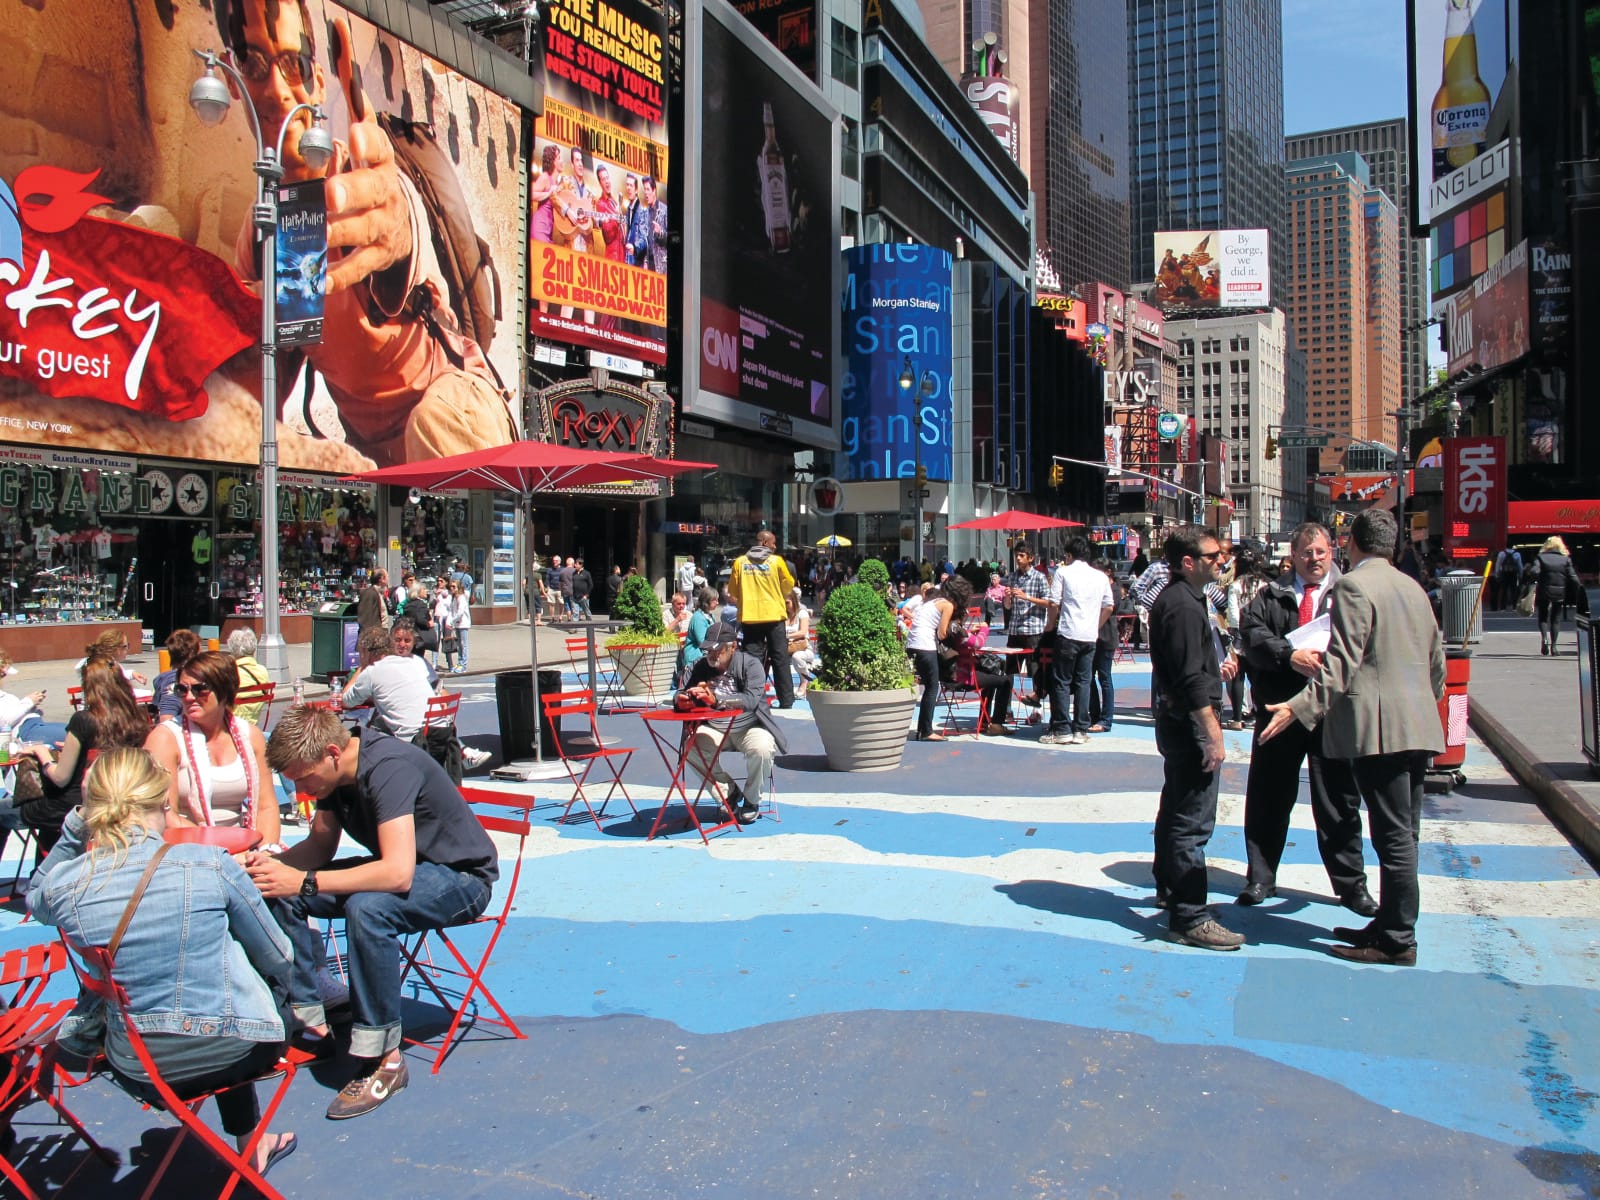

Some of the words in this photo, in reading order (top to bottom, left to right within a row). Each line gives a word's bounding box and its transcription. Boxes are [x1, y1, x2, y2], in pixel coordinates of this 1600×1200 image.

[598, 1, 662, 61] MUSIC
[550, 6, 581, 37] YOU
[583, 23, 664, 84] REMEMBER.
[546, 26, 575, 60] THE
[621, 67, 662, 106] YOU'LL
[546, 52, 601, 94] NEVER
[1437, 107, 1487, 126] Corona
[1447, 121, 1479, 132] Extra
[1430, 143, 1510, 209] INGLOT
[281, 213, 302, 232] Harry
[301, 210, 324, 232] Potter
[1225, 245, 1263, 257] George,
[1238, 234, 1250, 246] By
[1237, 257, 1251, 265] we
[1532, 247, 1571, 271] RAIN
[542, 247, 574, 285] 2nd
[577, 256, 629, 298] SMASH
[632, 270, 665, 307] YEAR
[1231, 266, 1246, 276] did
[1228, 283, 1260, 291] LEADERSHIP
[542, 280, 568, 299] ON
[572, 287, 665, 322] BROADWAY!
[872, 298, 909, 309] Morgan
[909, 298, 940, 313] Stanley
[702, 327, 737, 374] CNN
[37, 348, 111, 379] guest
[743, 358, 758, 372] Japan
[758, 363, 767, 376] PM
[26, 420, 48, 431] NEW
[50, 423, 72, 434] YORK
[1287, 438, 1294, 446] W
[1296, 438, 1308, 446] 47
[1459, 443, 1496, 513] tkts
[0, 467, 152, 514] GRAND
[679, 523, 704, 534] BLUE
